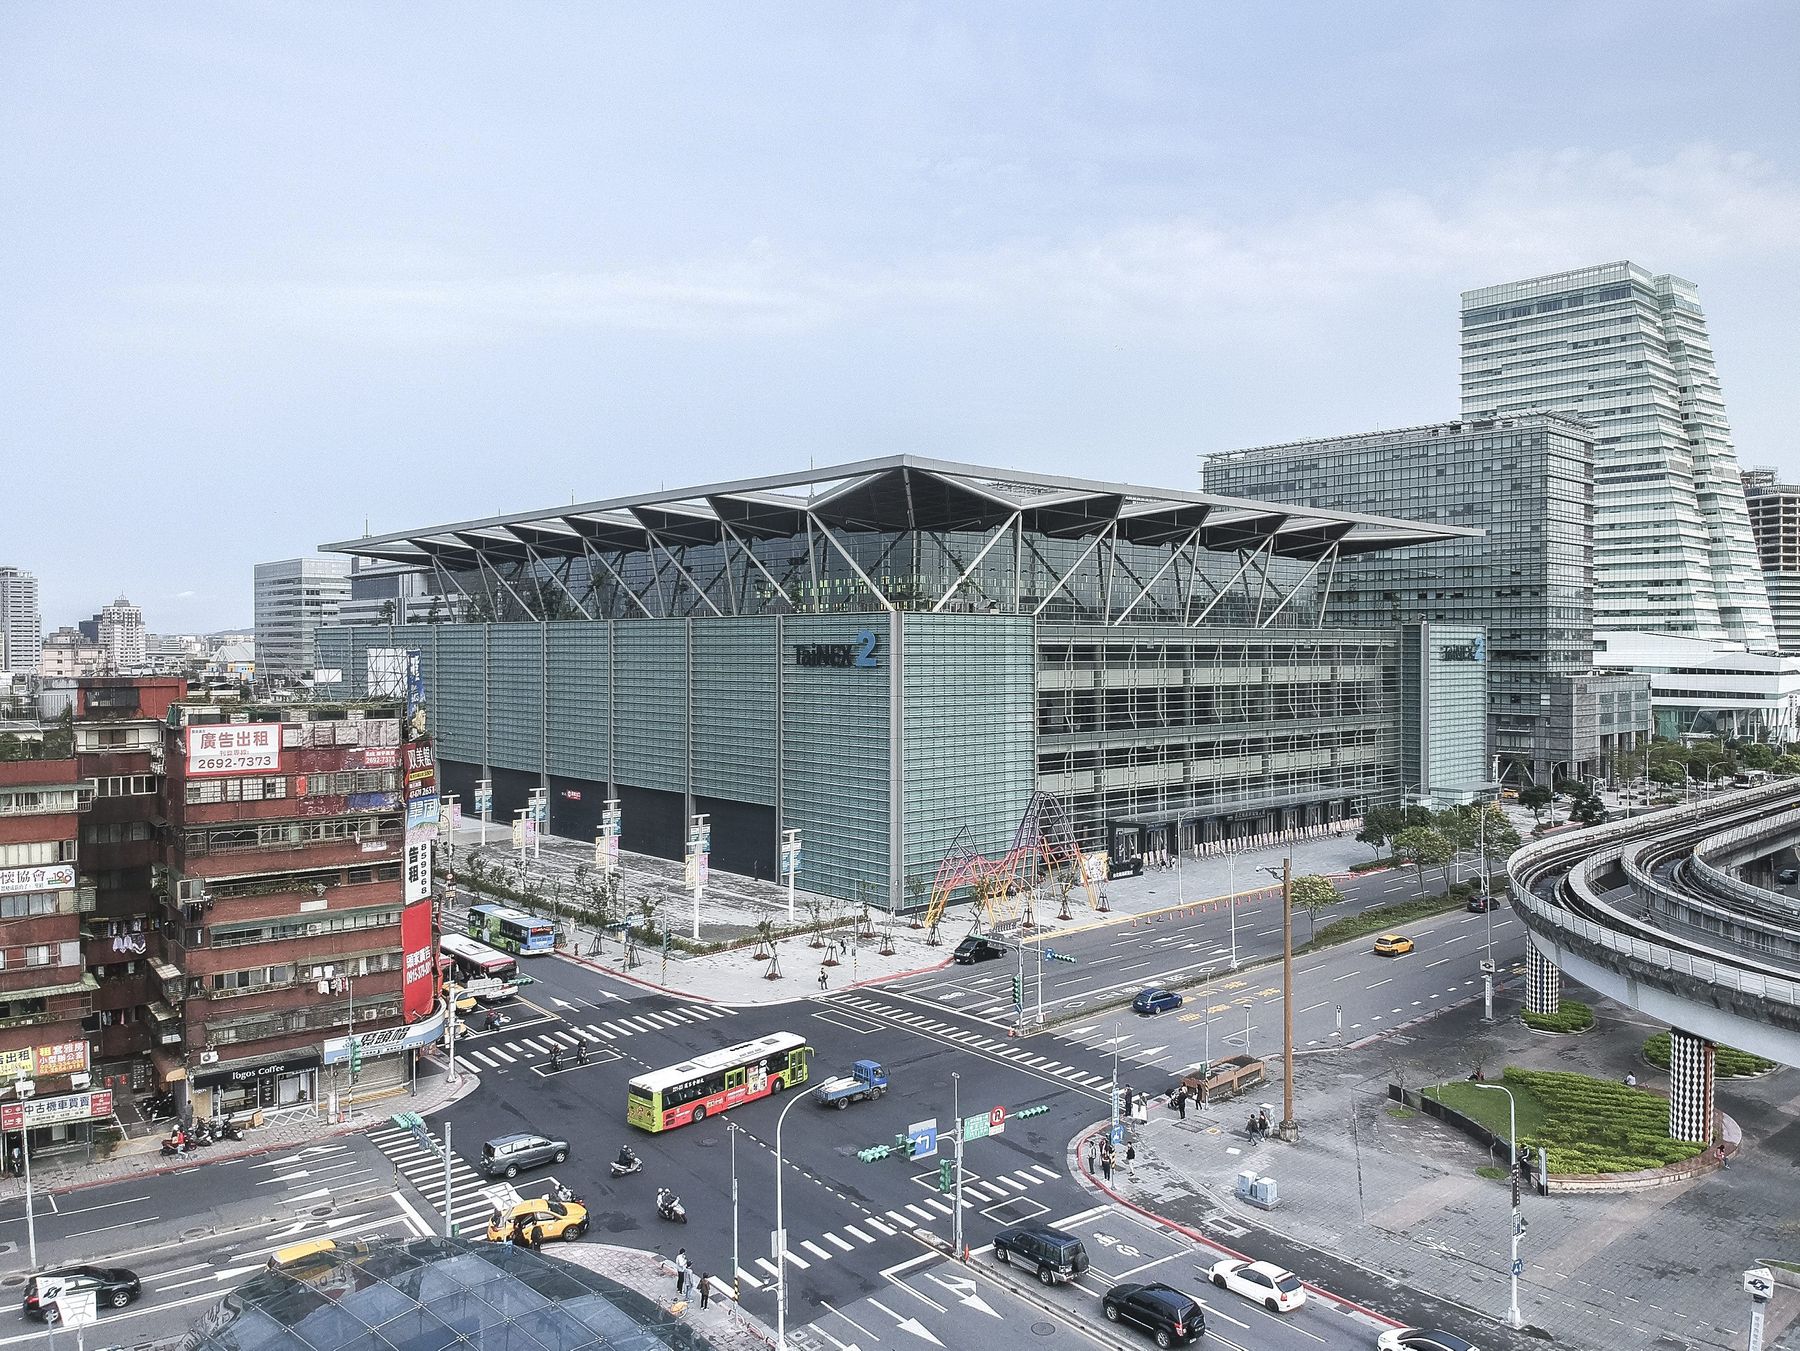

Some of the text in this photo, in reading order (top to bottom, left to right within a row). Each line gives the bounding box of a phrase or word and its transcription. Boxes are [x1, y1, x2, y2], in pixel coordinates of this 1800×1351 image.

[856, 629, 877, 666] 2
[200, 730, 269, 750] 廣告出租
[198, 755, 272, 769] 2692-7373
[258, 1064, 285, 1076] Coffee
[24, 1096, 90, 1115] 中古機車買賣
